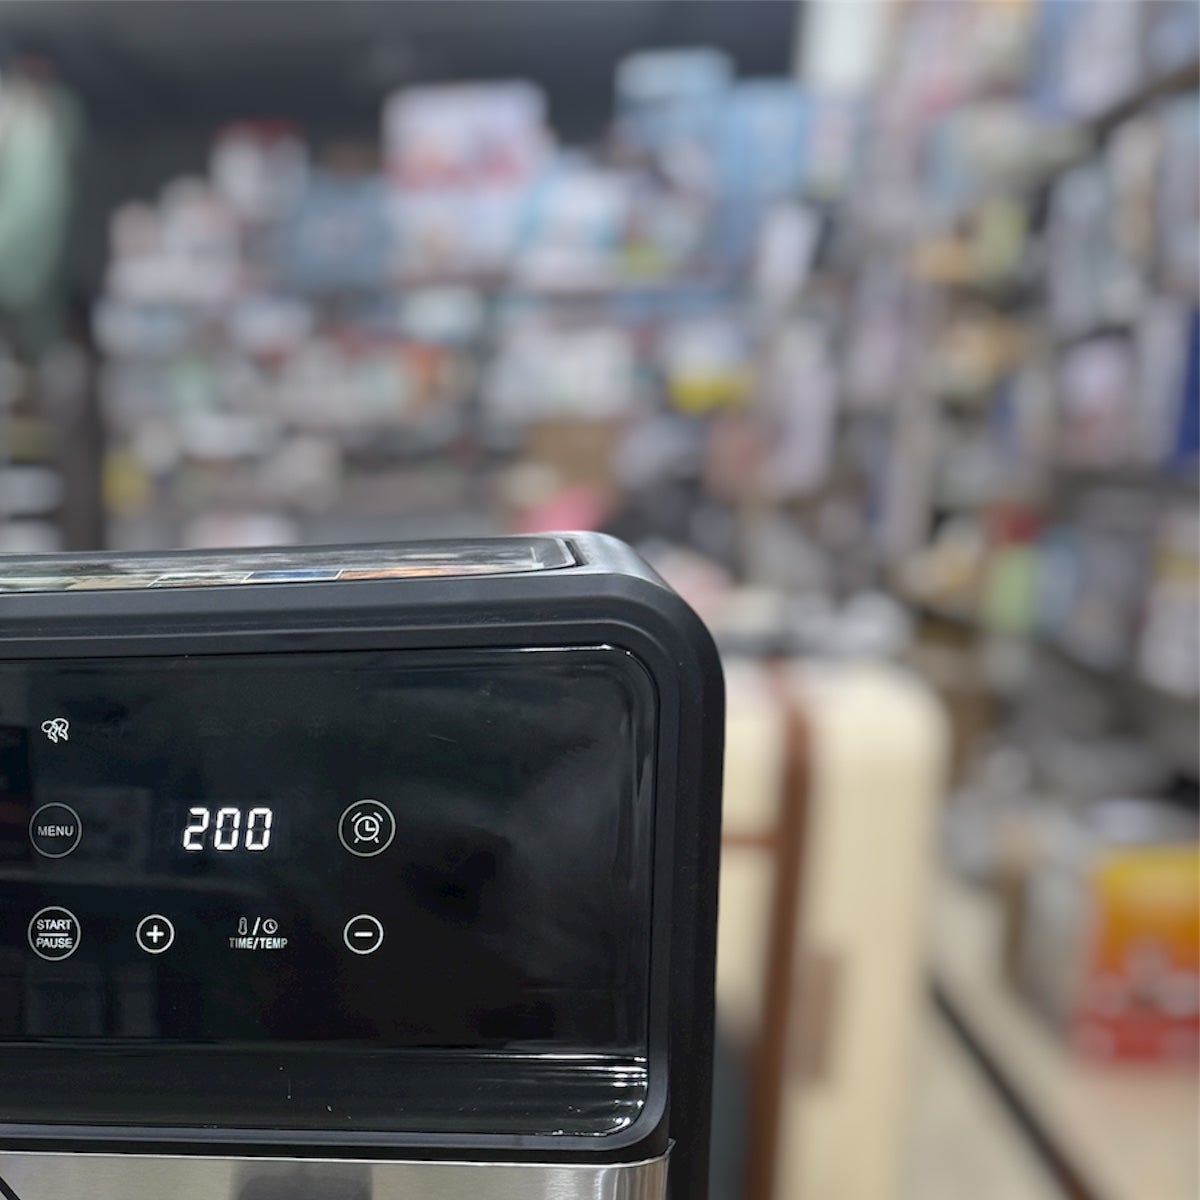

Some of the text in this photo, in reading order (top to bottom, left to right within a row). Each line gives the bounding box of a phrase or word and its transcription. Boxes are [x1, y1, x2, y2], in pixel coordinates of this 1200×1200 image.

[37, 825, 75, 838] MENU
[182, 807, 273, 851] 200
[36, 919, 73, 931] START
[36, 937, 73, 949] PAUSE
[228, 937, 289, 950] TIME/TEMP
